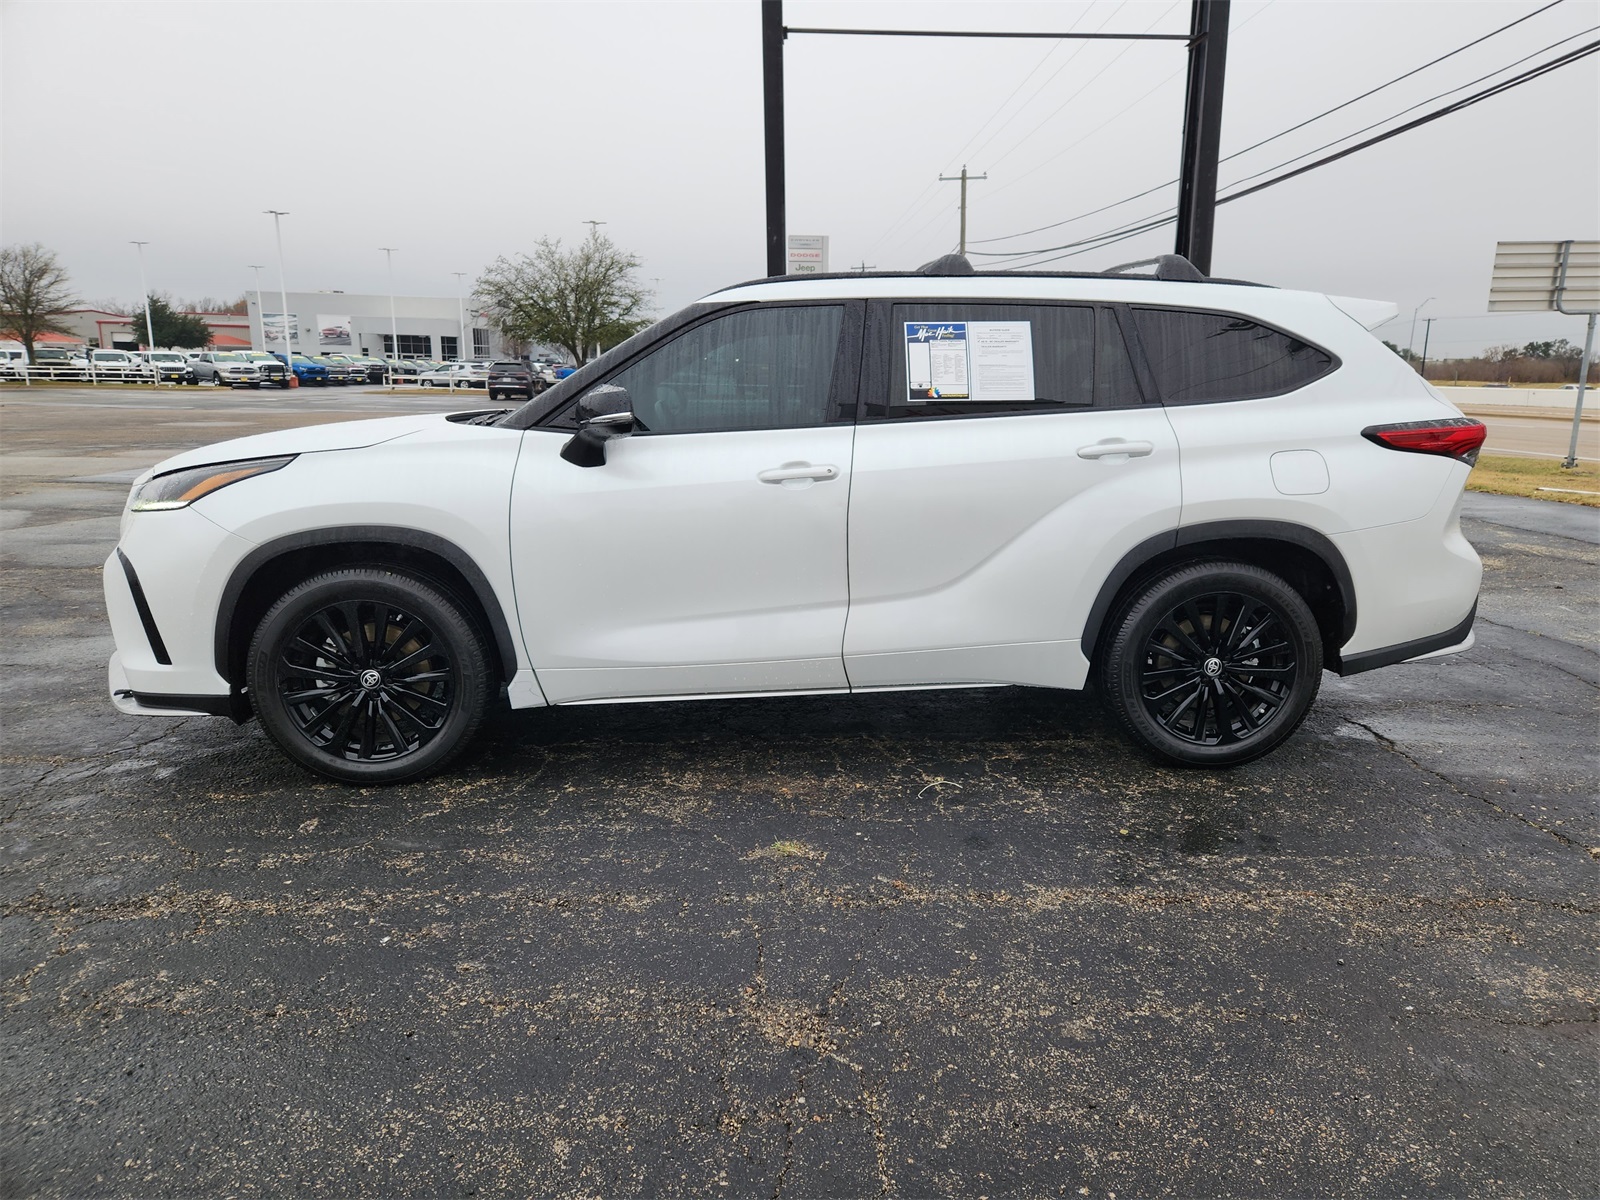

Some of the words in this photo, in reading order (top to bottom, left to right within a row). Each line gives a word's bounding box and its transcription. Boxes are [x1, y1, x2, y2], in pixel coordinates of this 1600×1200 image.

[795, 264, 816, 272] Jeep
[1272, 592, 1310, 639] MICHELIN
[1128, 701, 1167, 748] MICHELIN
